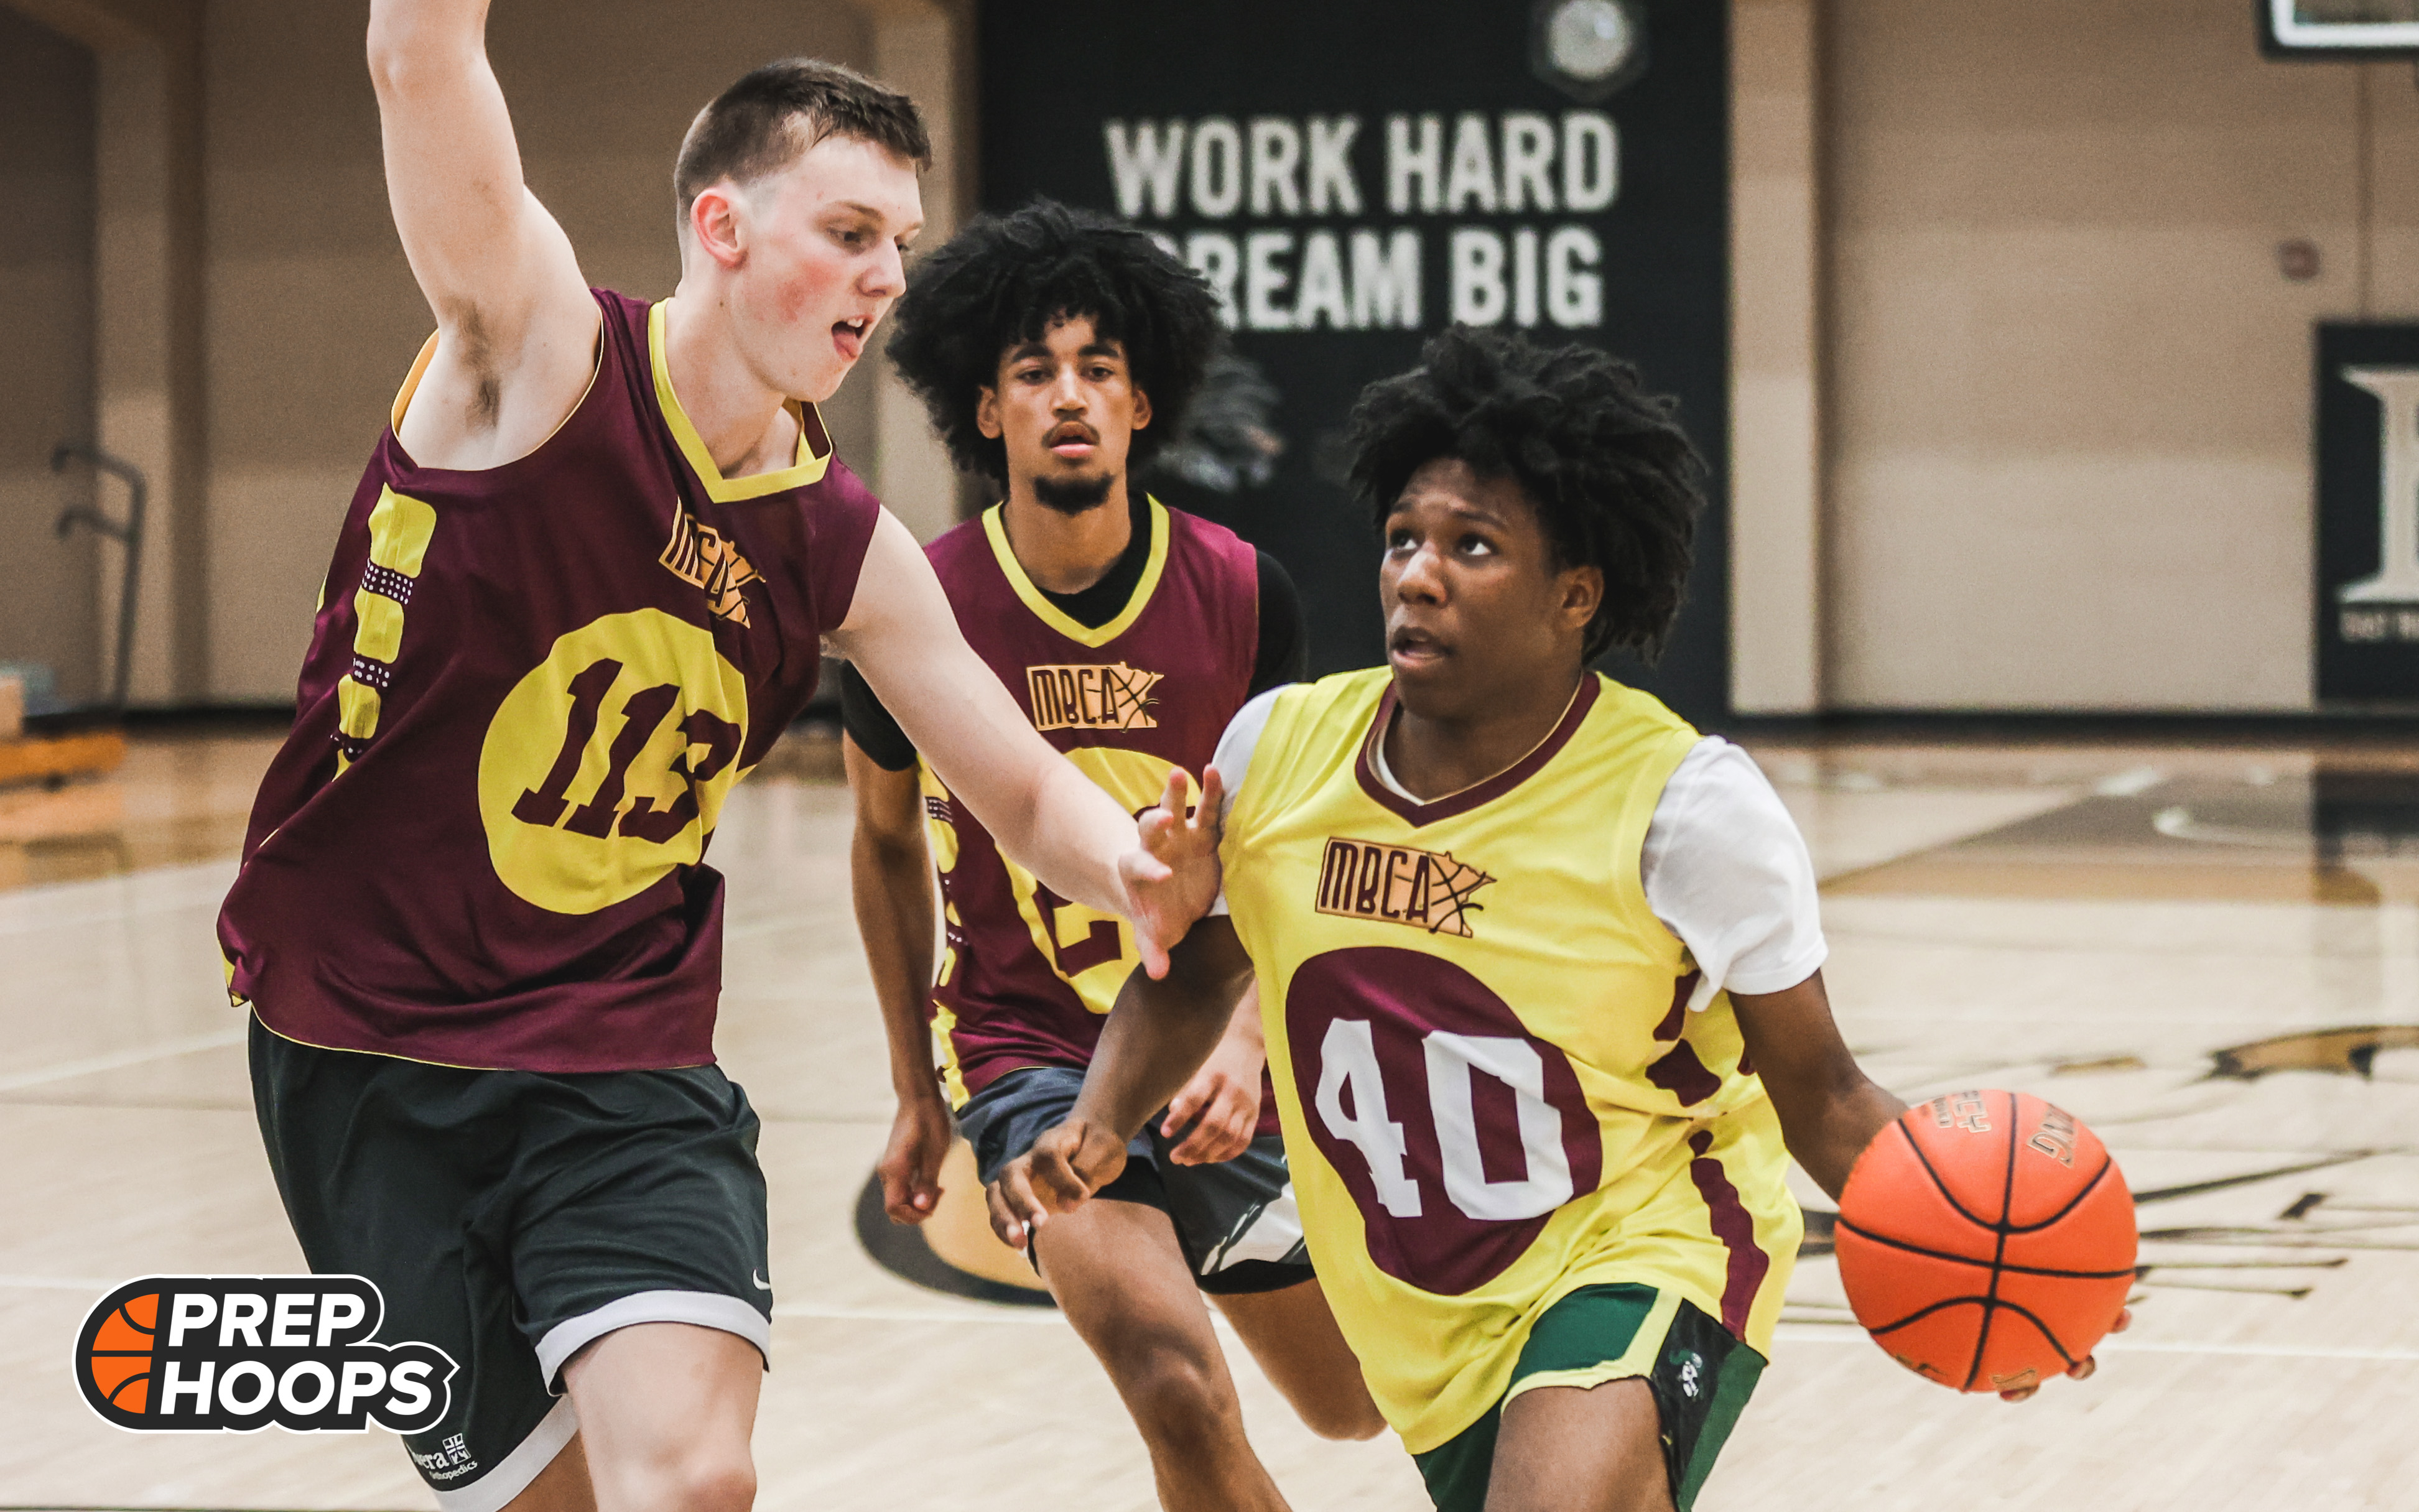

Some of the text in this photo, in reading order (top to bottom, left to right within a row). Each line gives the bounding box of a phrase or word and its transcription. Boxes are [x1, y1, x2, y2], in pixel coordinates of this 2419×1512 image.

[1103, 110, 1621, 219] WORK HARD
[1151, 224, 1605, 331] REAM BIG
[1031, 668, 1120, 726] MBCA
[1319, 840, 1431, 923] MBCA
[1315, 1017, 1575, 1220] 40
